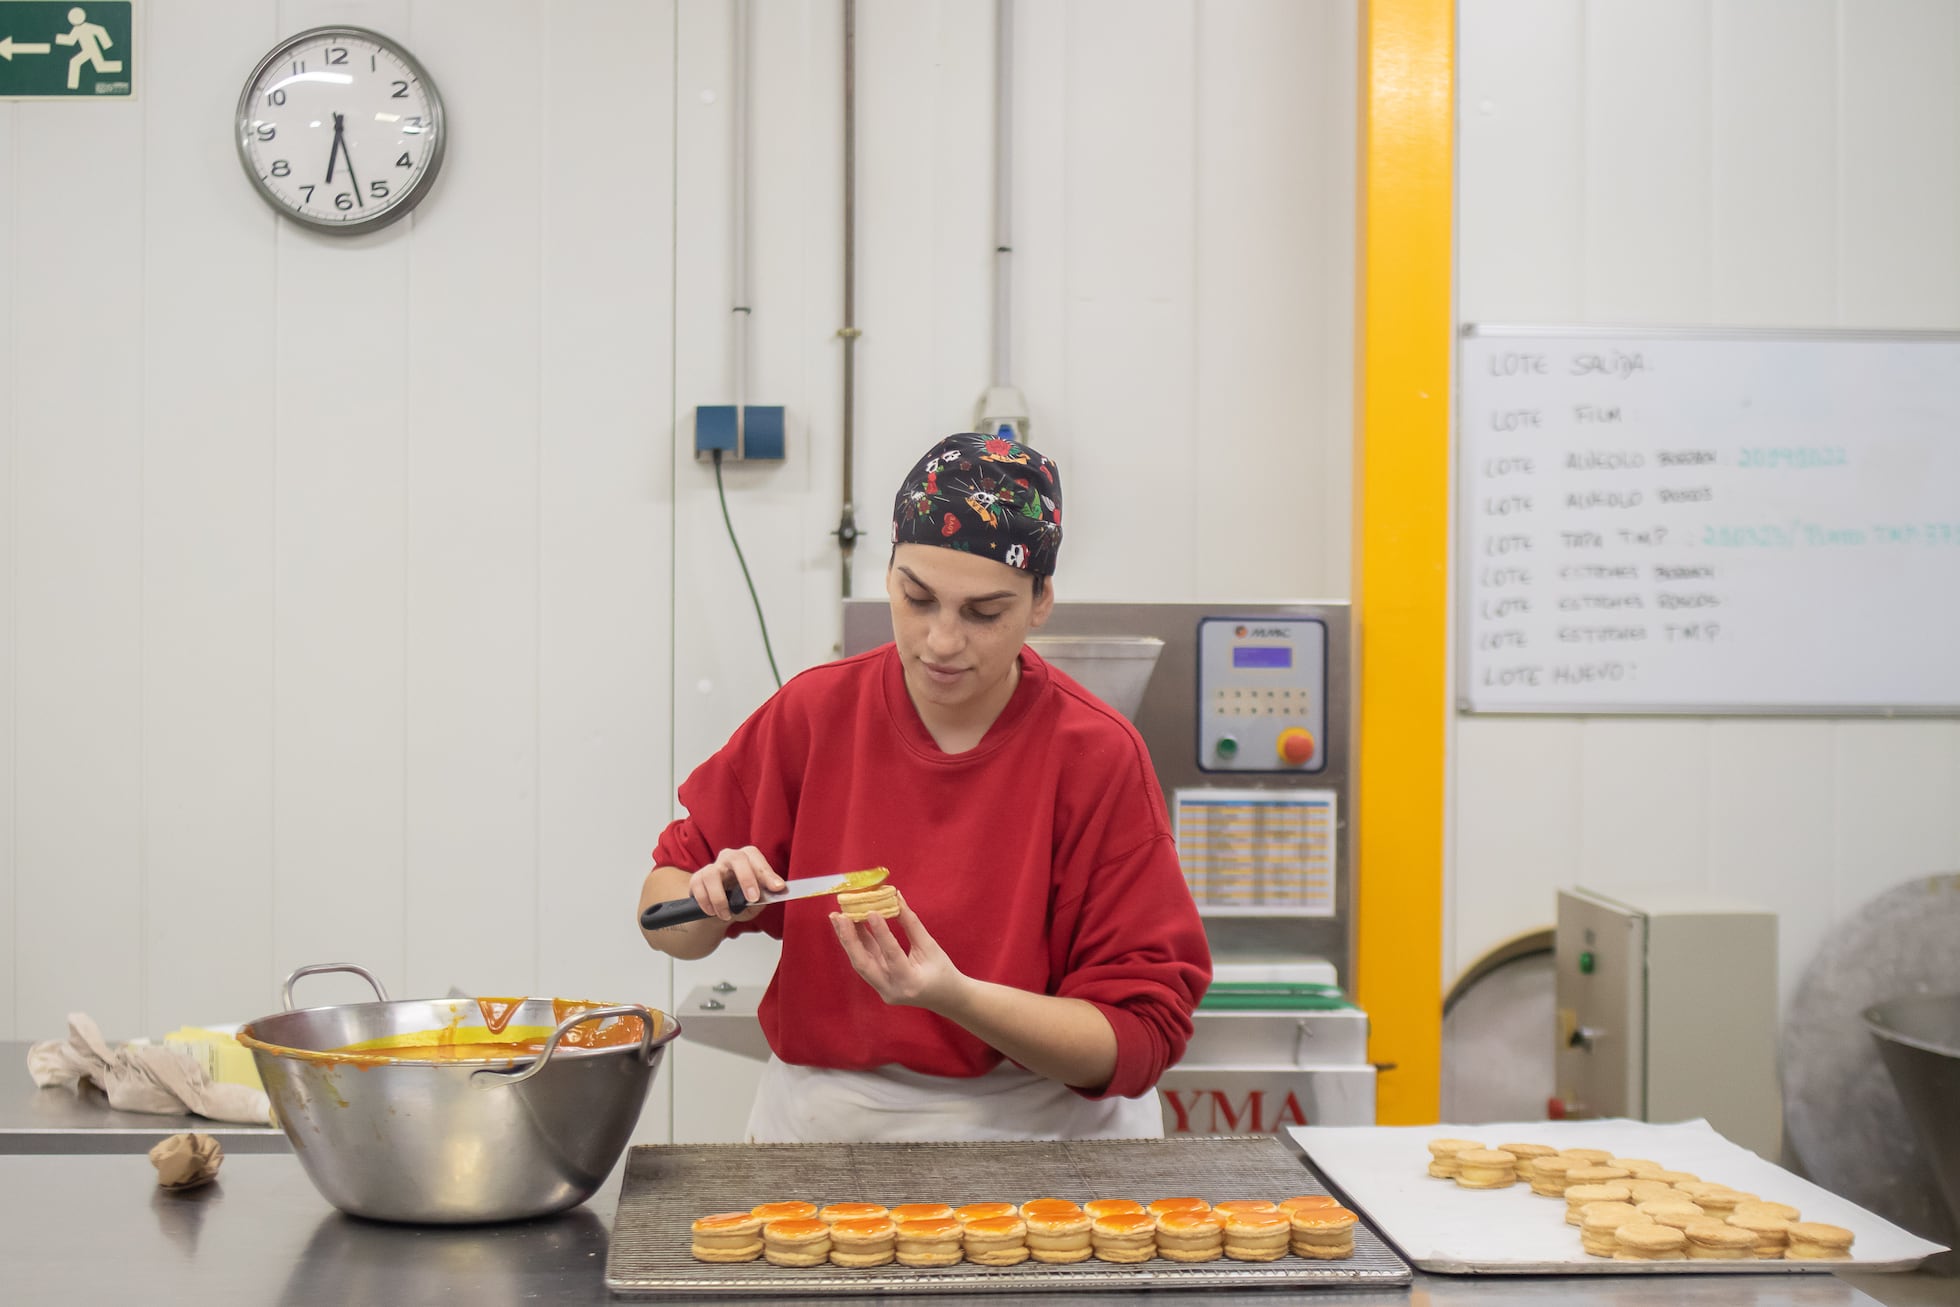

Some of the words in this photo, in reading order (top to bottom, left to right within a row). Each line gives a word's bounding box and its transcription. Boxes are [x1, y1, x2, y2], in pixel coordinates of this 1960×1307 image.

[325, 47, 349, 65] 12
[371, 55, 376, 73] 1
[293, 61, 305, 76] 11
[268, 89, 286, 107] 10
[391, 80, 410, 99] 2
[256, 122, 276, 142] 9
[271, 160, 291, 178] 8
[396, 152, 413, 169] 4
[299, 185, 316, 204] 7
[371, 180, 390, 199] 5
[335, 193, 353, 211] 6
[1488, 353, 1550, 378] LOTE
[1491, 408, 1544, 432] LOTE
[1484, 457, 1537, 478] LOTE
[1485, 496, 1535, 516] LOTE
[1485, 533, 1537, 556] LOTE
[1481, 566, 1534, 587] LOTE
[1481, 598, 1533, 620] LOTE
[1480, 630, 1529, 651] LOTE
[1484, 664, 1543, 687] LOTE
